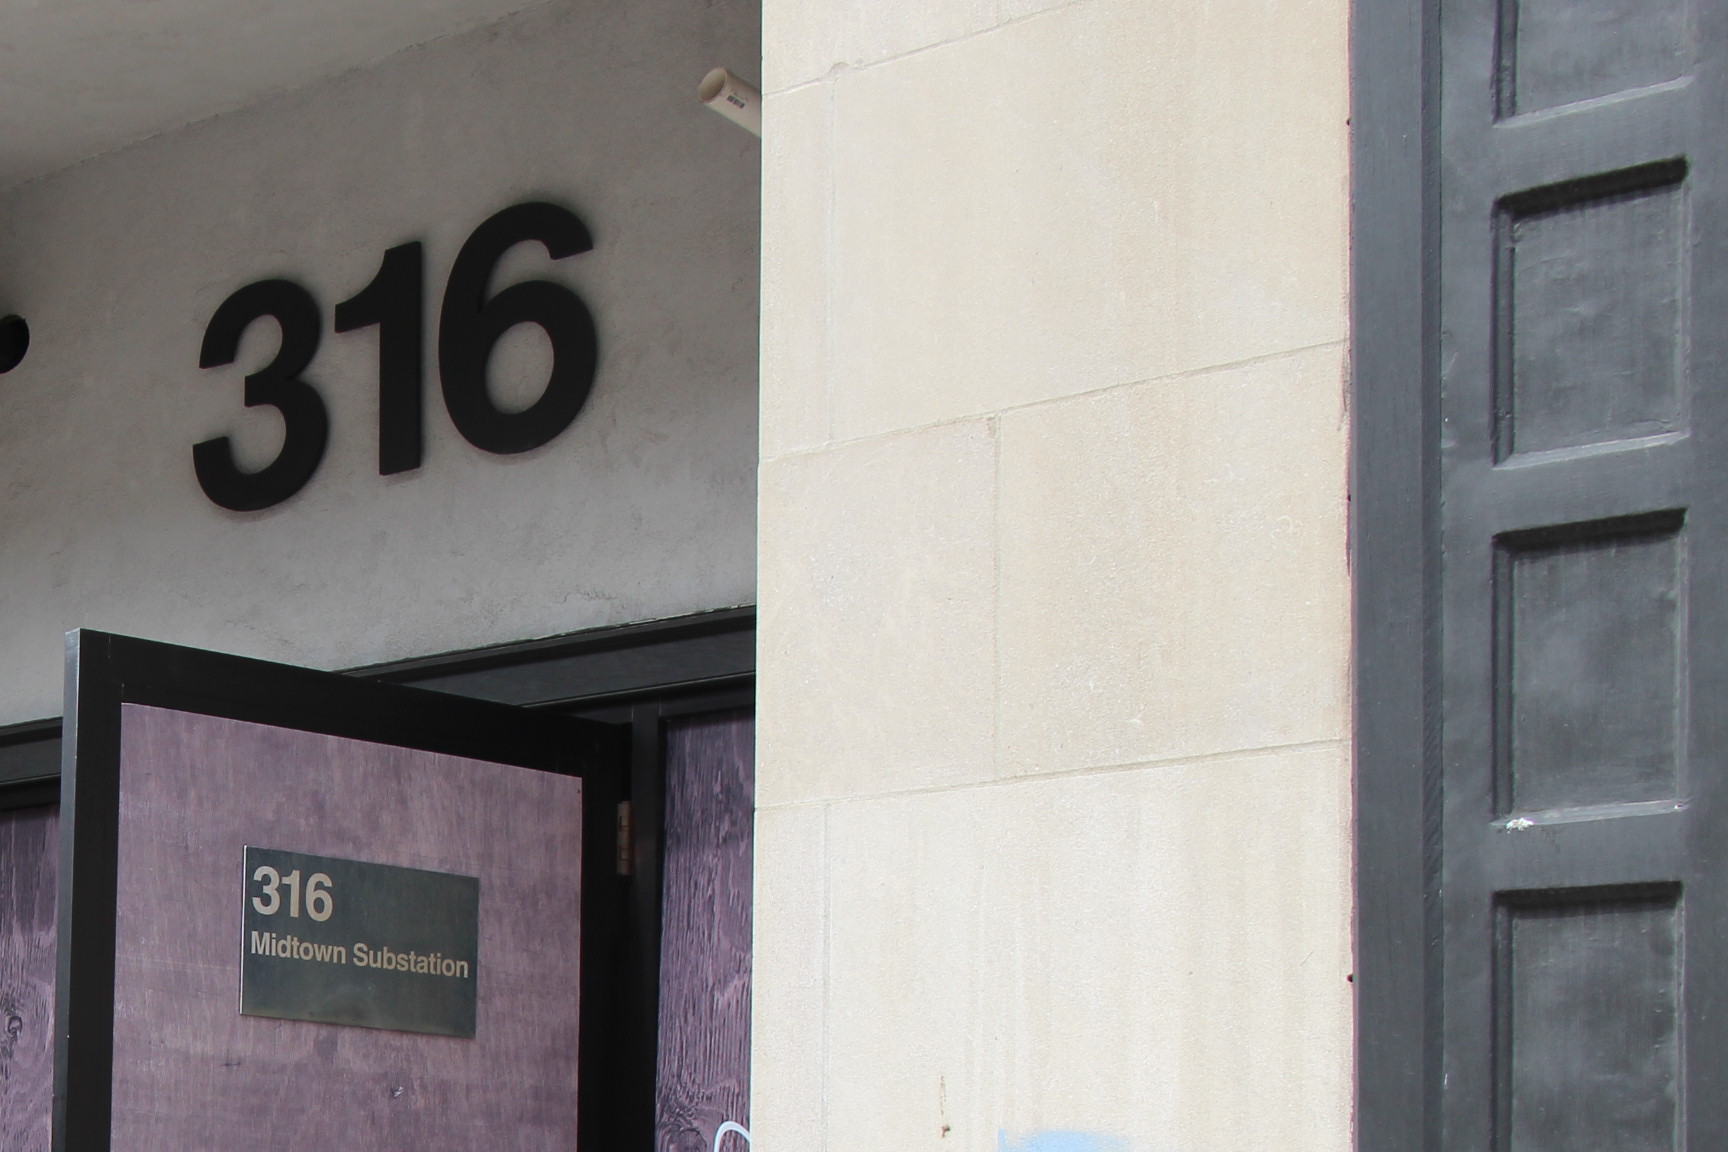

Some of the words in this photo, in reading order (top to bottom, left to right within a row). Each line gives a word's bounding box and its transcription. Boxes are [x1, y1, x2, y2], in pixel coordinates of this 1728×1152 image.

[192, 201, 597, 512] 316
[252, 865, 333, 922] 316
[251, 931, 346, 964] Midtown
[353, 943, 469, 978] Substation
